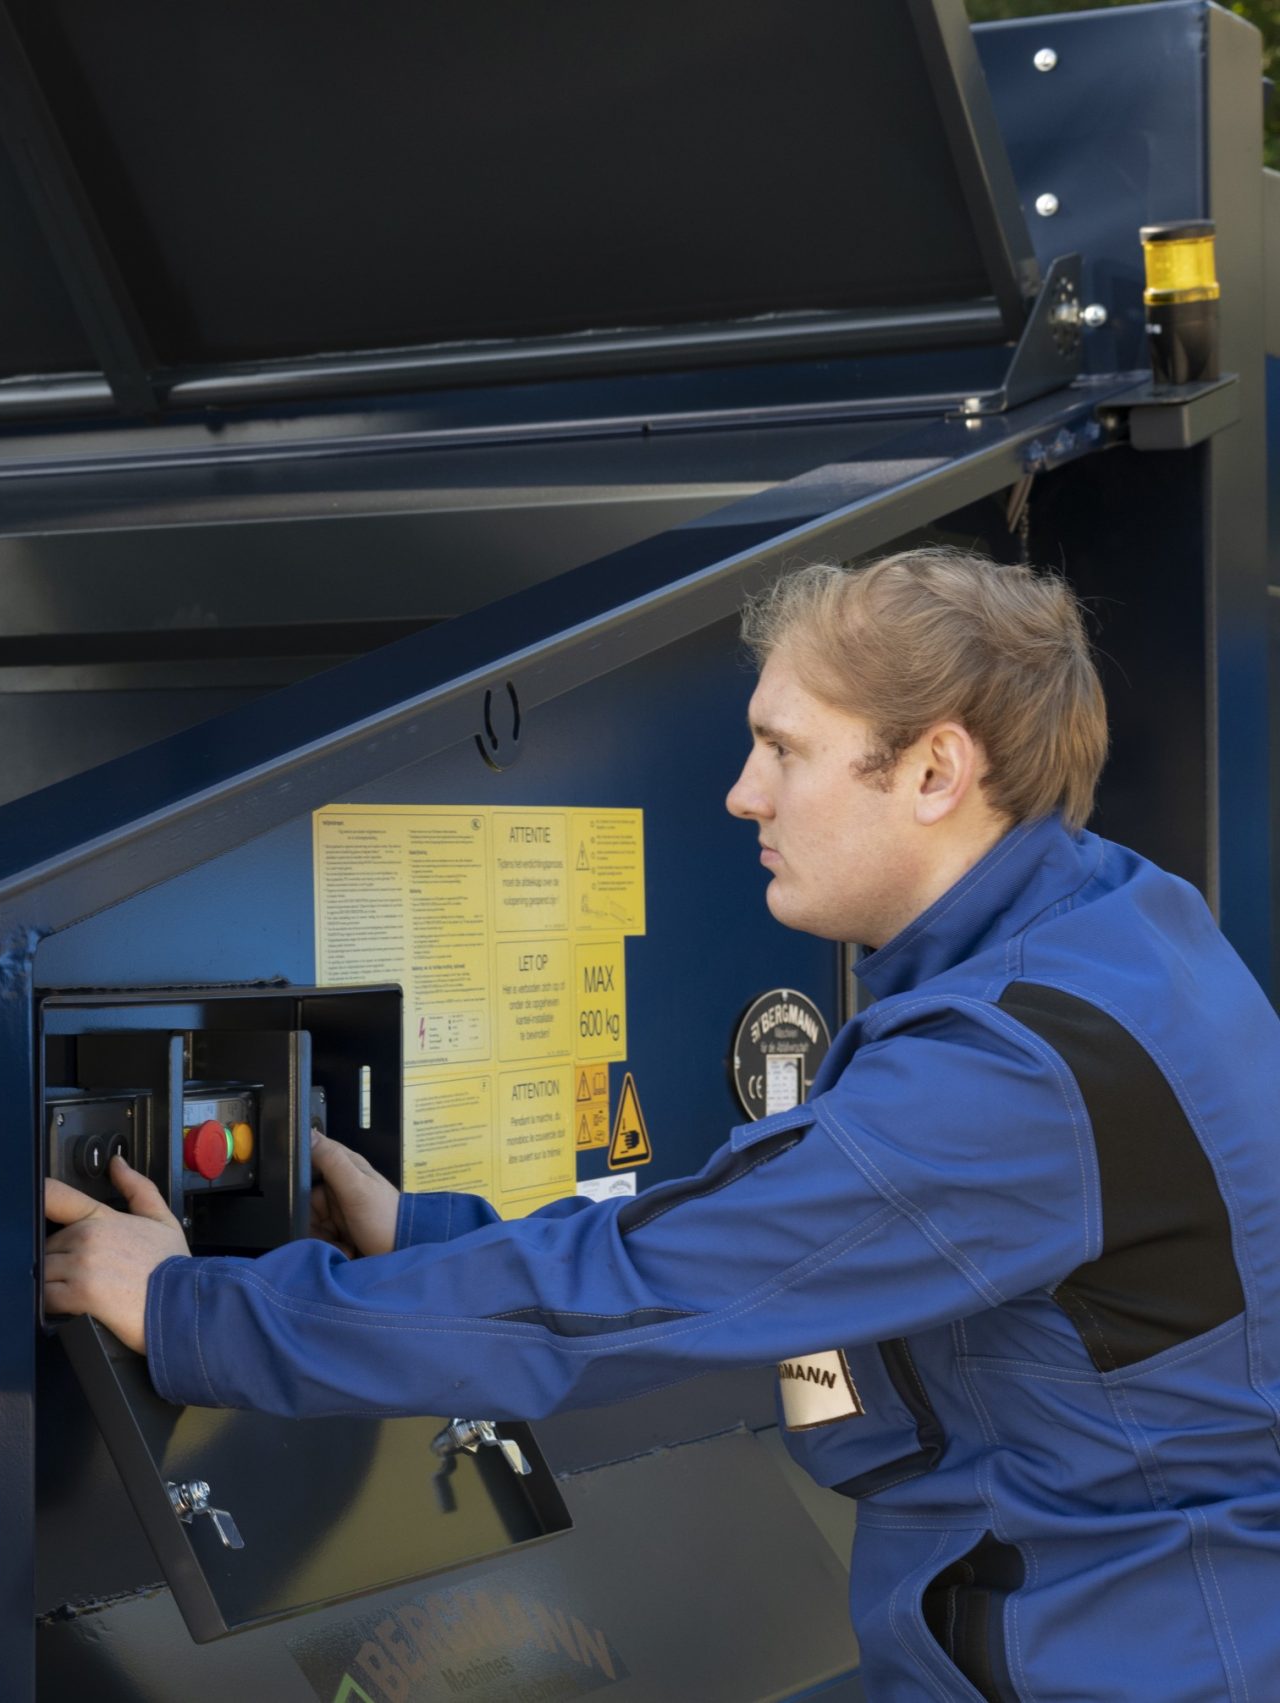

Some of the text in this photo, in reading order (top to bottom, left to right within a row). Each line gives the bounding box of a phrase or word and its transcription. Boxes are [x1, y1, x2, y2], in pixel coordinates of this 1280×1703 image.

[509, 826, 551, 843] ATTENTIE
[519, 954, 549, 972] LET OP
[584, 965, 615, 994] MAX
[580, 1008, 620, 1041] 600 kg
[761, 1004, 819, 1044] BERGMANN
[511, 1080, 560, 1101] ATTENTION
[440, 1656, 515, 1701] Machines
